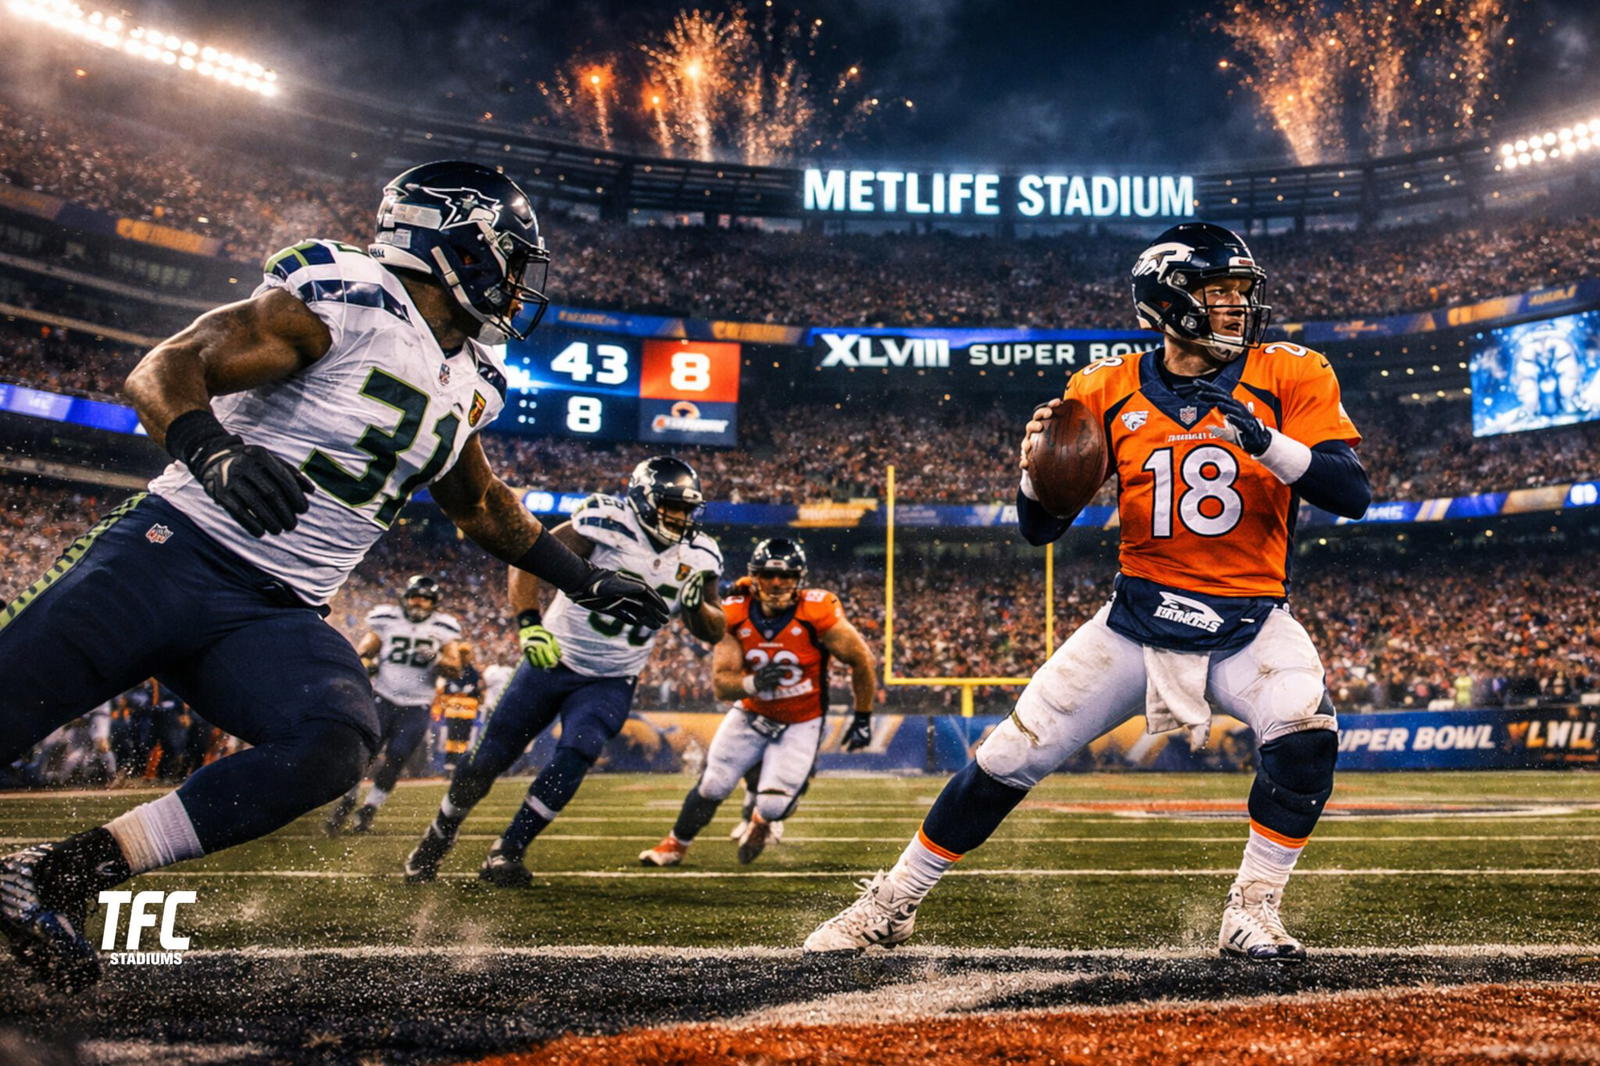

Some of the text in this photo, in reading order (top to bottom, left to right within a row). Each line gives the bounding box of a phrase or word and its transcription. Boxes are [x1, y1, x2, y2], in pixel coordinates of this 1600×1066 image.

[803, 169, 1195, 217] METLIFE STADIUM
[551, 341, 629, 385] 43
[821, 334, 1161, 367] XLVIII SUPER BOW
[670, 352, 711, 391] 8
[566, 396, 602, 433] 8
[300, 366, 462, 531] 31
[1142, 444, 1243, 538] 18
[1337, 727, 1409, 752] UPER
[1412, 725, 1496, 750] BOWL
